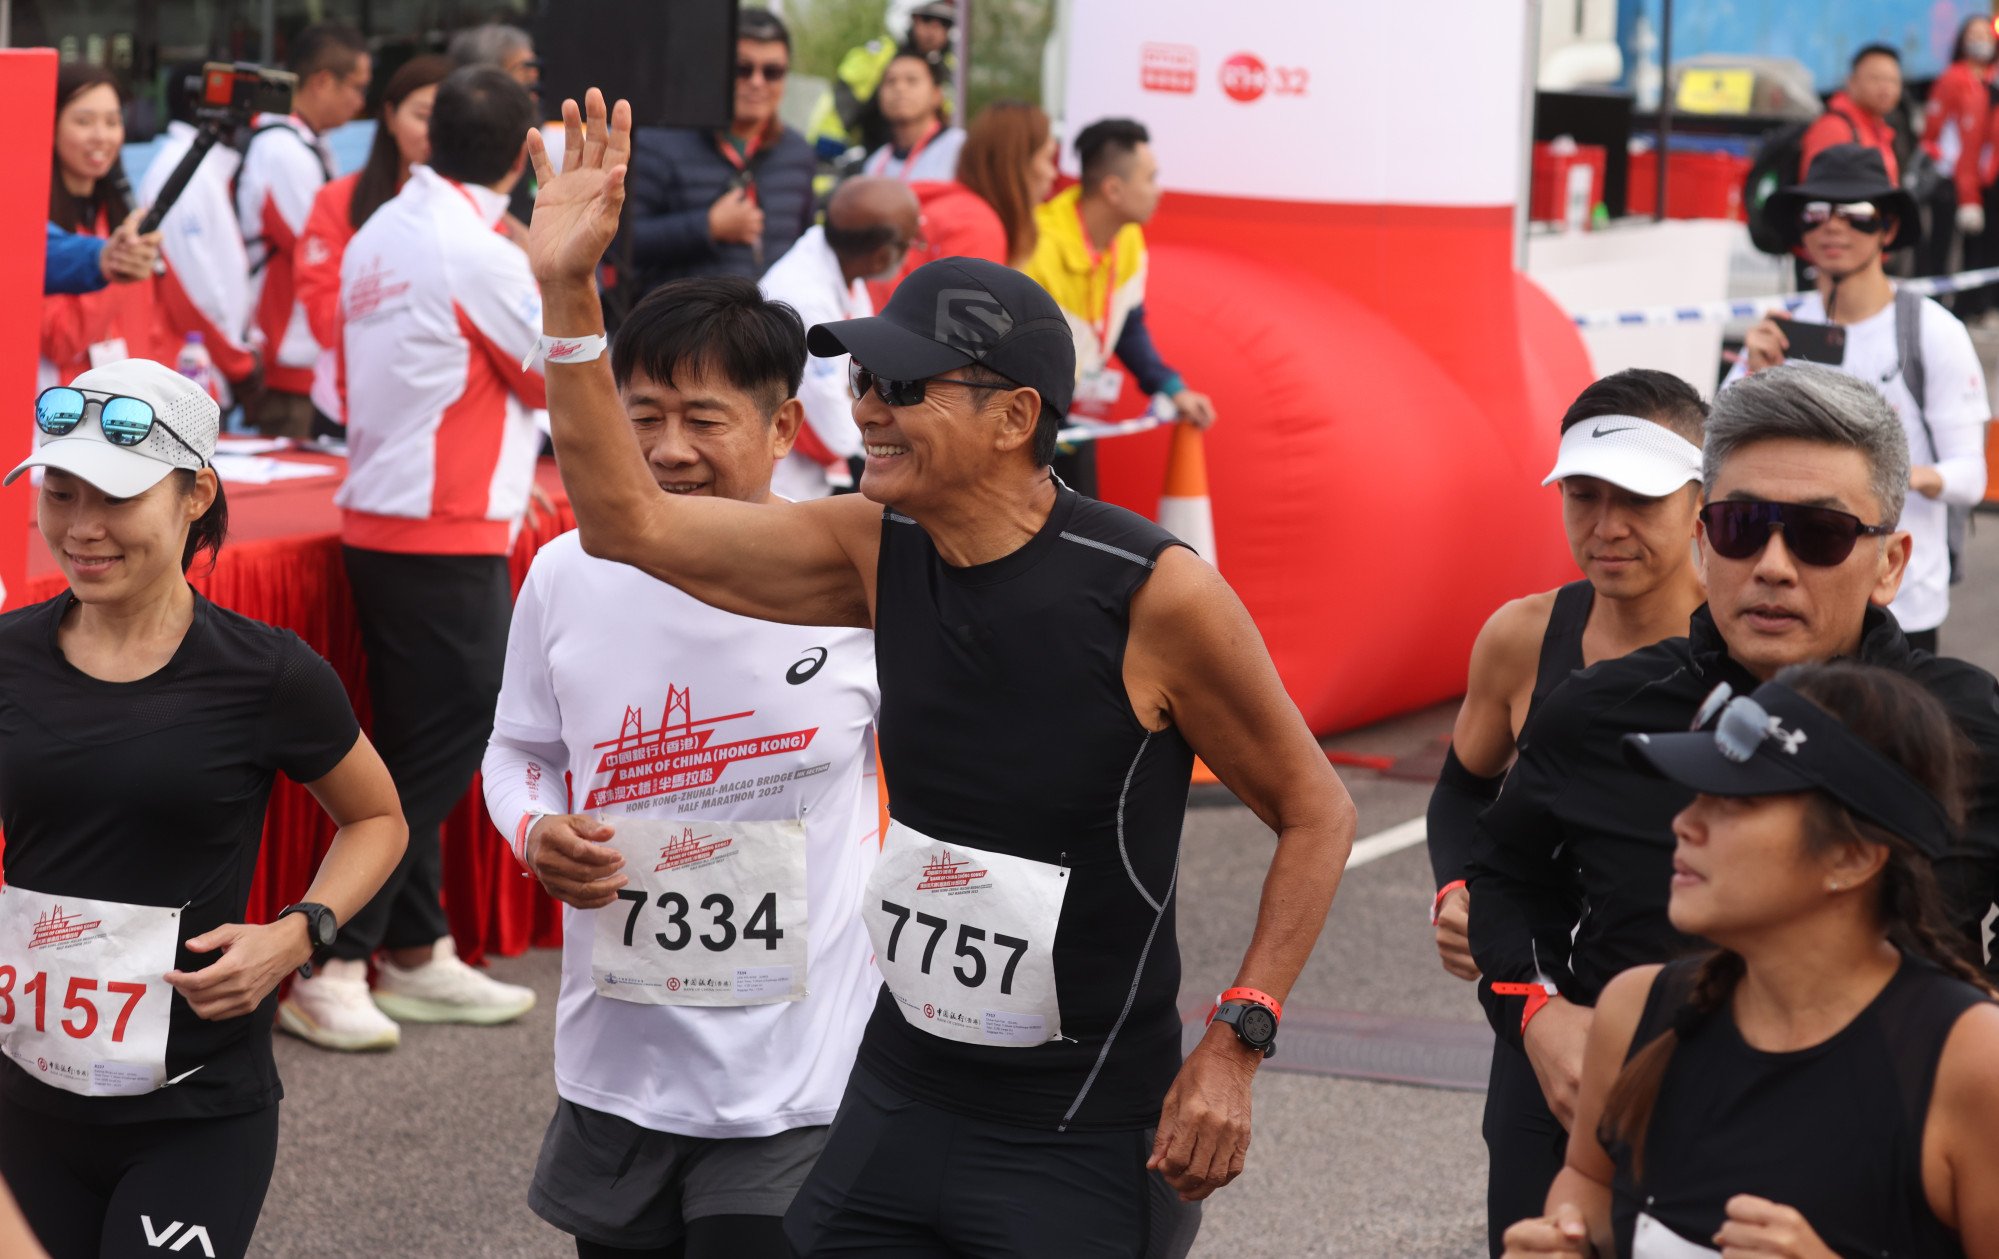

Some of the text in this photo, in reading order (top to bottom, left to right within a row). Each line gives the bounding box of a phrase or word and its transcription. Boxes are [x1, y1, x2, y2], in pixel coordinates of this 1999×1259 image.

[620, 763, 654, 780] BANK
[655, 760, 671, 773] OF
[760, 734, 806, 752] KONG)
[626, 800, 650, 813] HONG
[757, 772, 793, 786] BRIDGE
[678, 785, 784, 813] HALF MARATHON 2023
[617, 889, 784, 952] 7334
[881, 899, 1028, 995] 7757
[140, 1214, 216, 1258] VA
